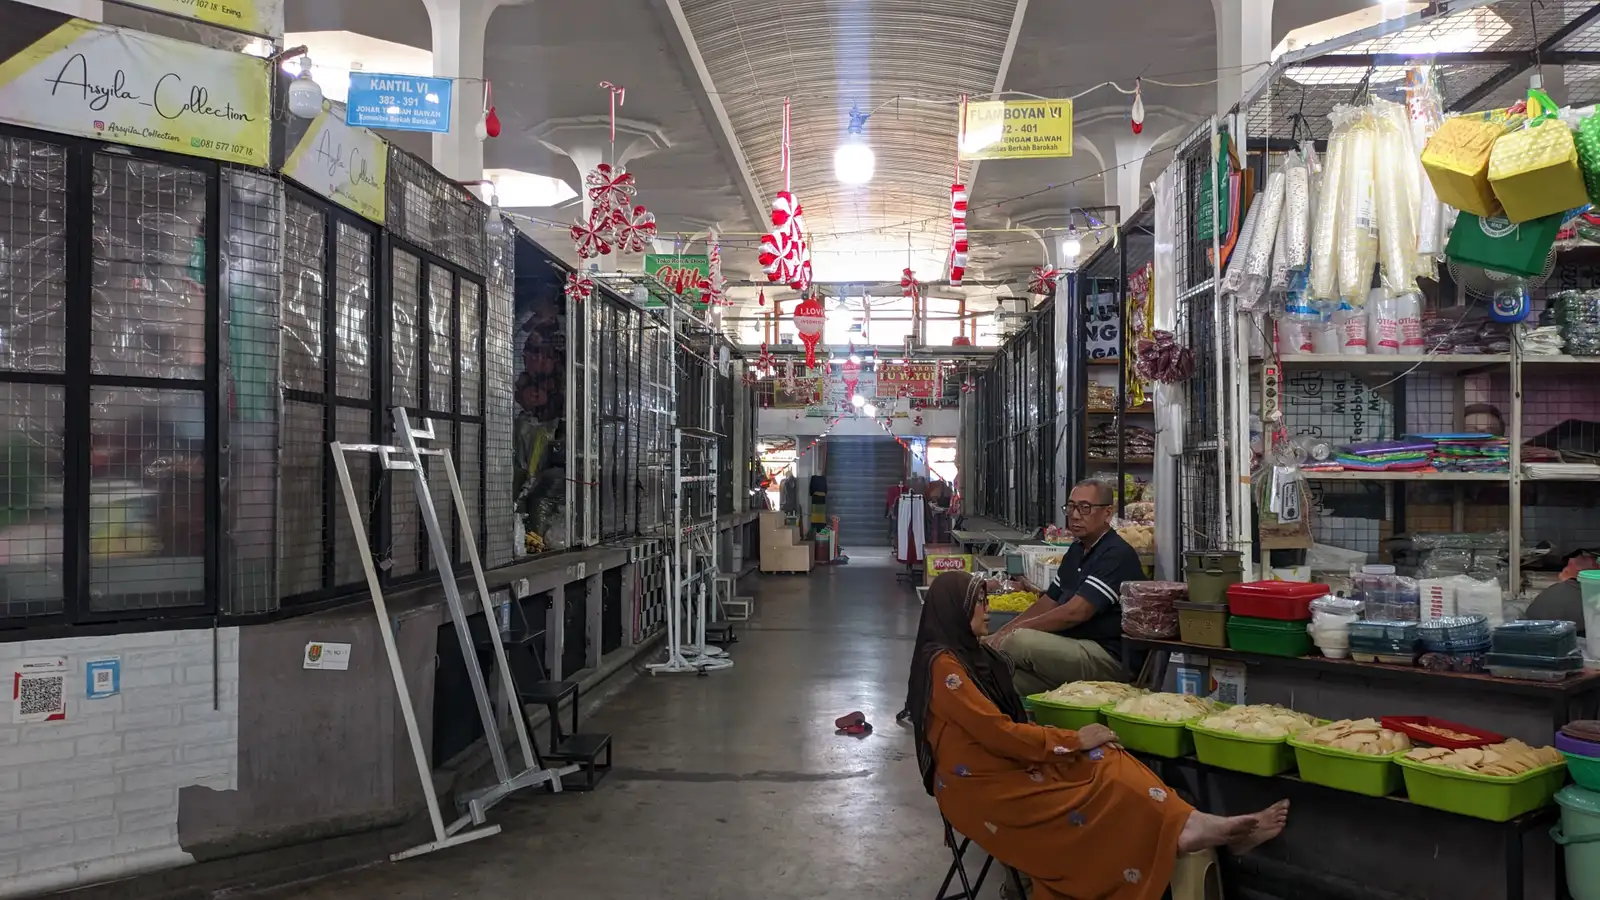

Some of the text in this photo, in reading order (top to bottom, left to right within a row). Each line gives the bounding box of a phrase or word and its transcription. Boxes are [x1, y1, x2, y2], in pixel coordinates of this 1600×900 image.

[196, 0, 209, 8] 107
[210, 3, 218, 11] 18
[221, 5, 241, 18] Ening
[370, 79, 428, 94] KANTIL VI
[378, 95, 395, 105] 382
[403, 97, 418, 107] 391
[356, 105, 380, 113] JOHAR
[414, 109, 441, 118] BAWAH
[970, 107, 1062, 121] FLAMBOYAN VI
[1021, 125, 1038, 133] 401
[200, 140, 253, 156] 081 577 107 18
[1008, 144, 1031, 152] Berkah
[1333, 380, 1345, 413] Minal
